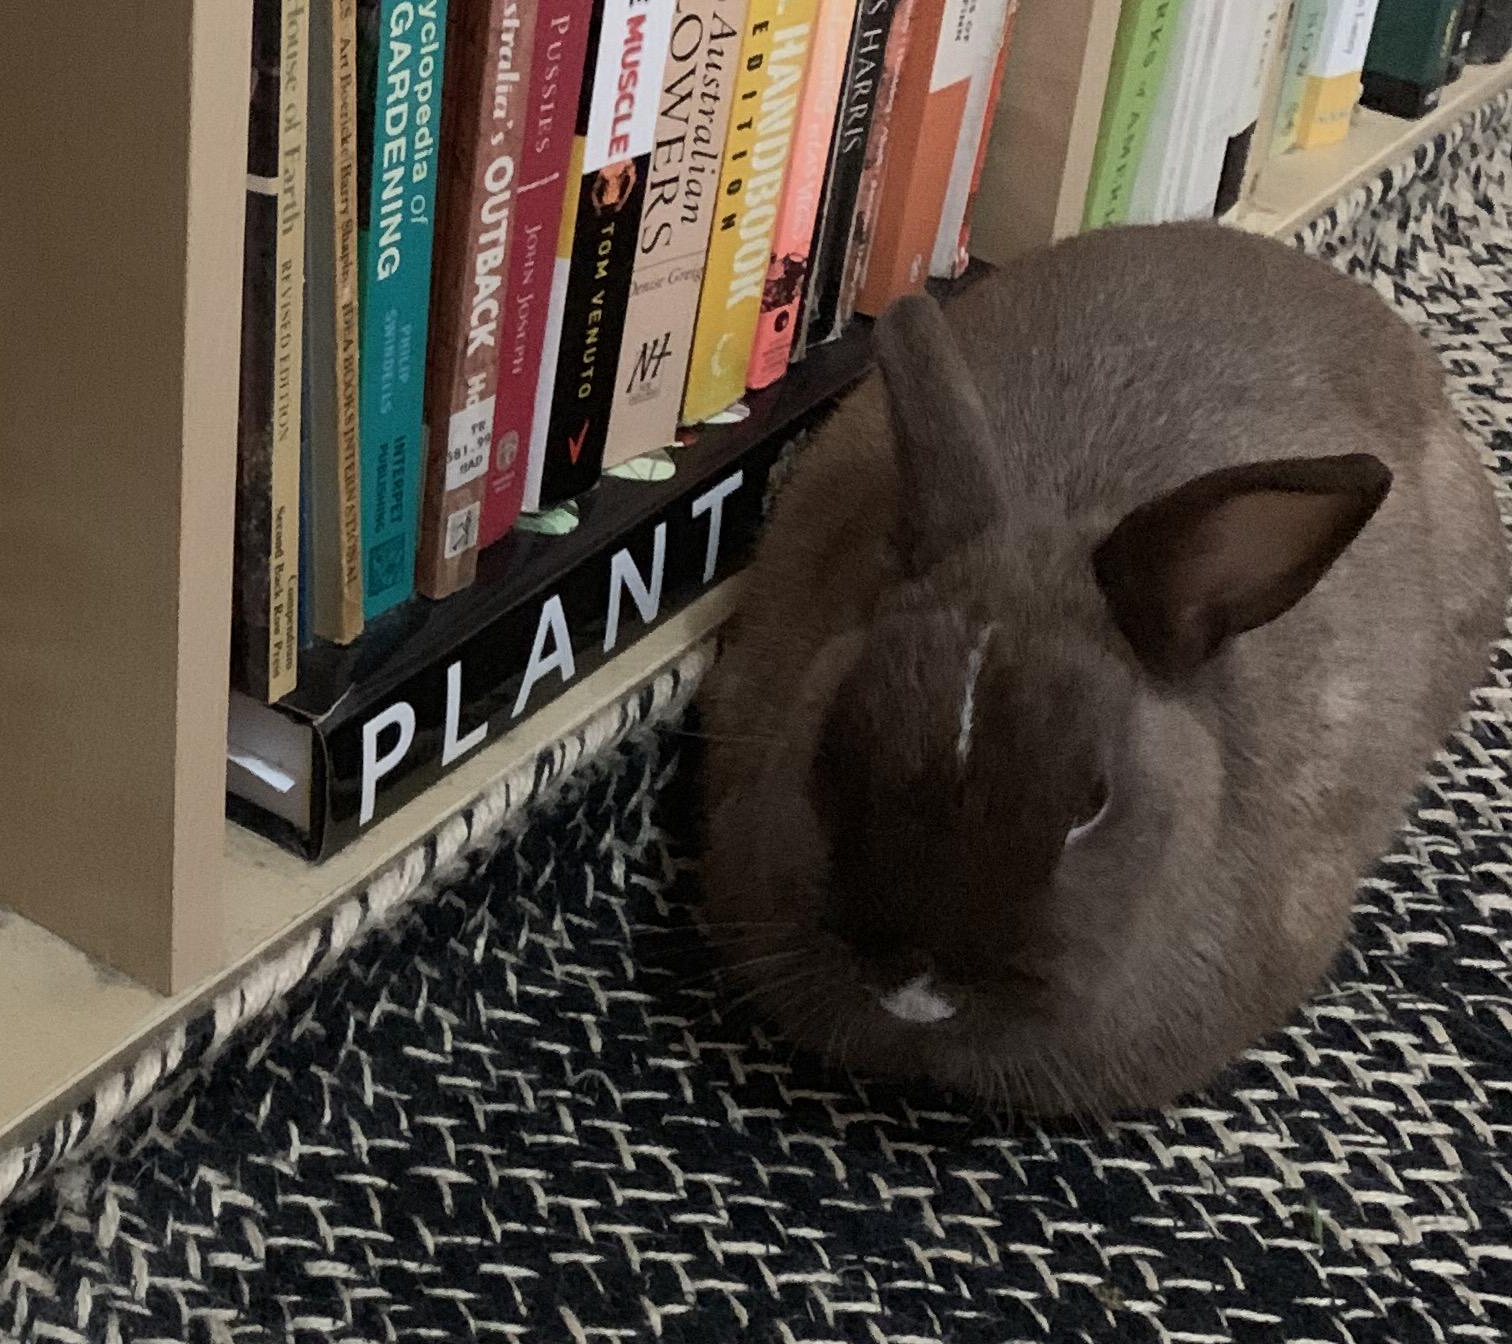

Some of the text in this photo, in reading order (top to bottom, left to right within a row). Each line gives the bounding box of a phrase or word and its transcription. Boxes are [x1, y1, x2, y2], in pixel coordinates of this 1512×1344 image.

[376, 2, 415, 282] GARDENING
[608, 14, 648, 159] MUSCLE
[681, 11, 739, 224] Australian
[721, 20, 769, 232] EDITION
[842, 29, 884, 155] HARRIS
[280, 146, 301, 236] Earth
[411, 196, 428, 225] of
[726, 23, 811, 312] HANDBOOK
[467, 158, 515, 356] OUTBACK
[594, 221, 615, 281] TOM
[397, 323, 413, 384] PHILIP
[578, 288, 605, 400] VENUTO
[391, 434, 407, 525] INTERPET
